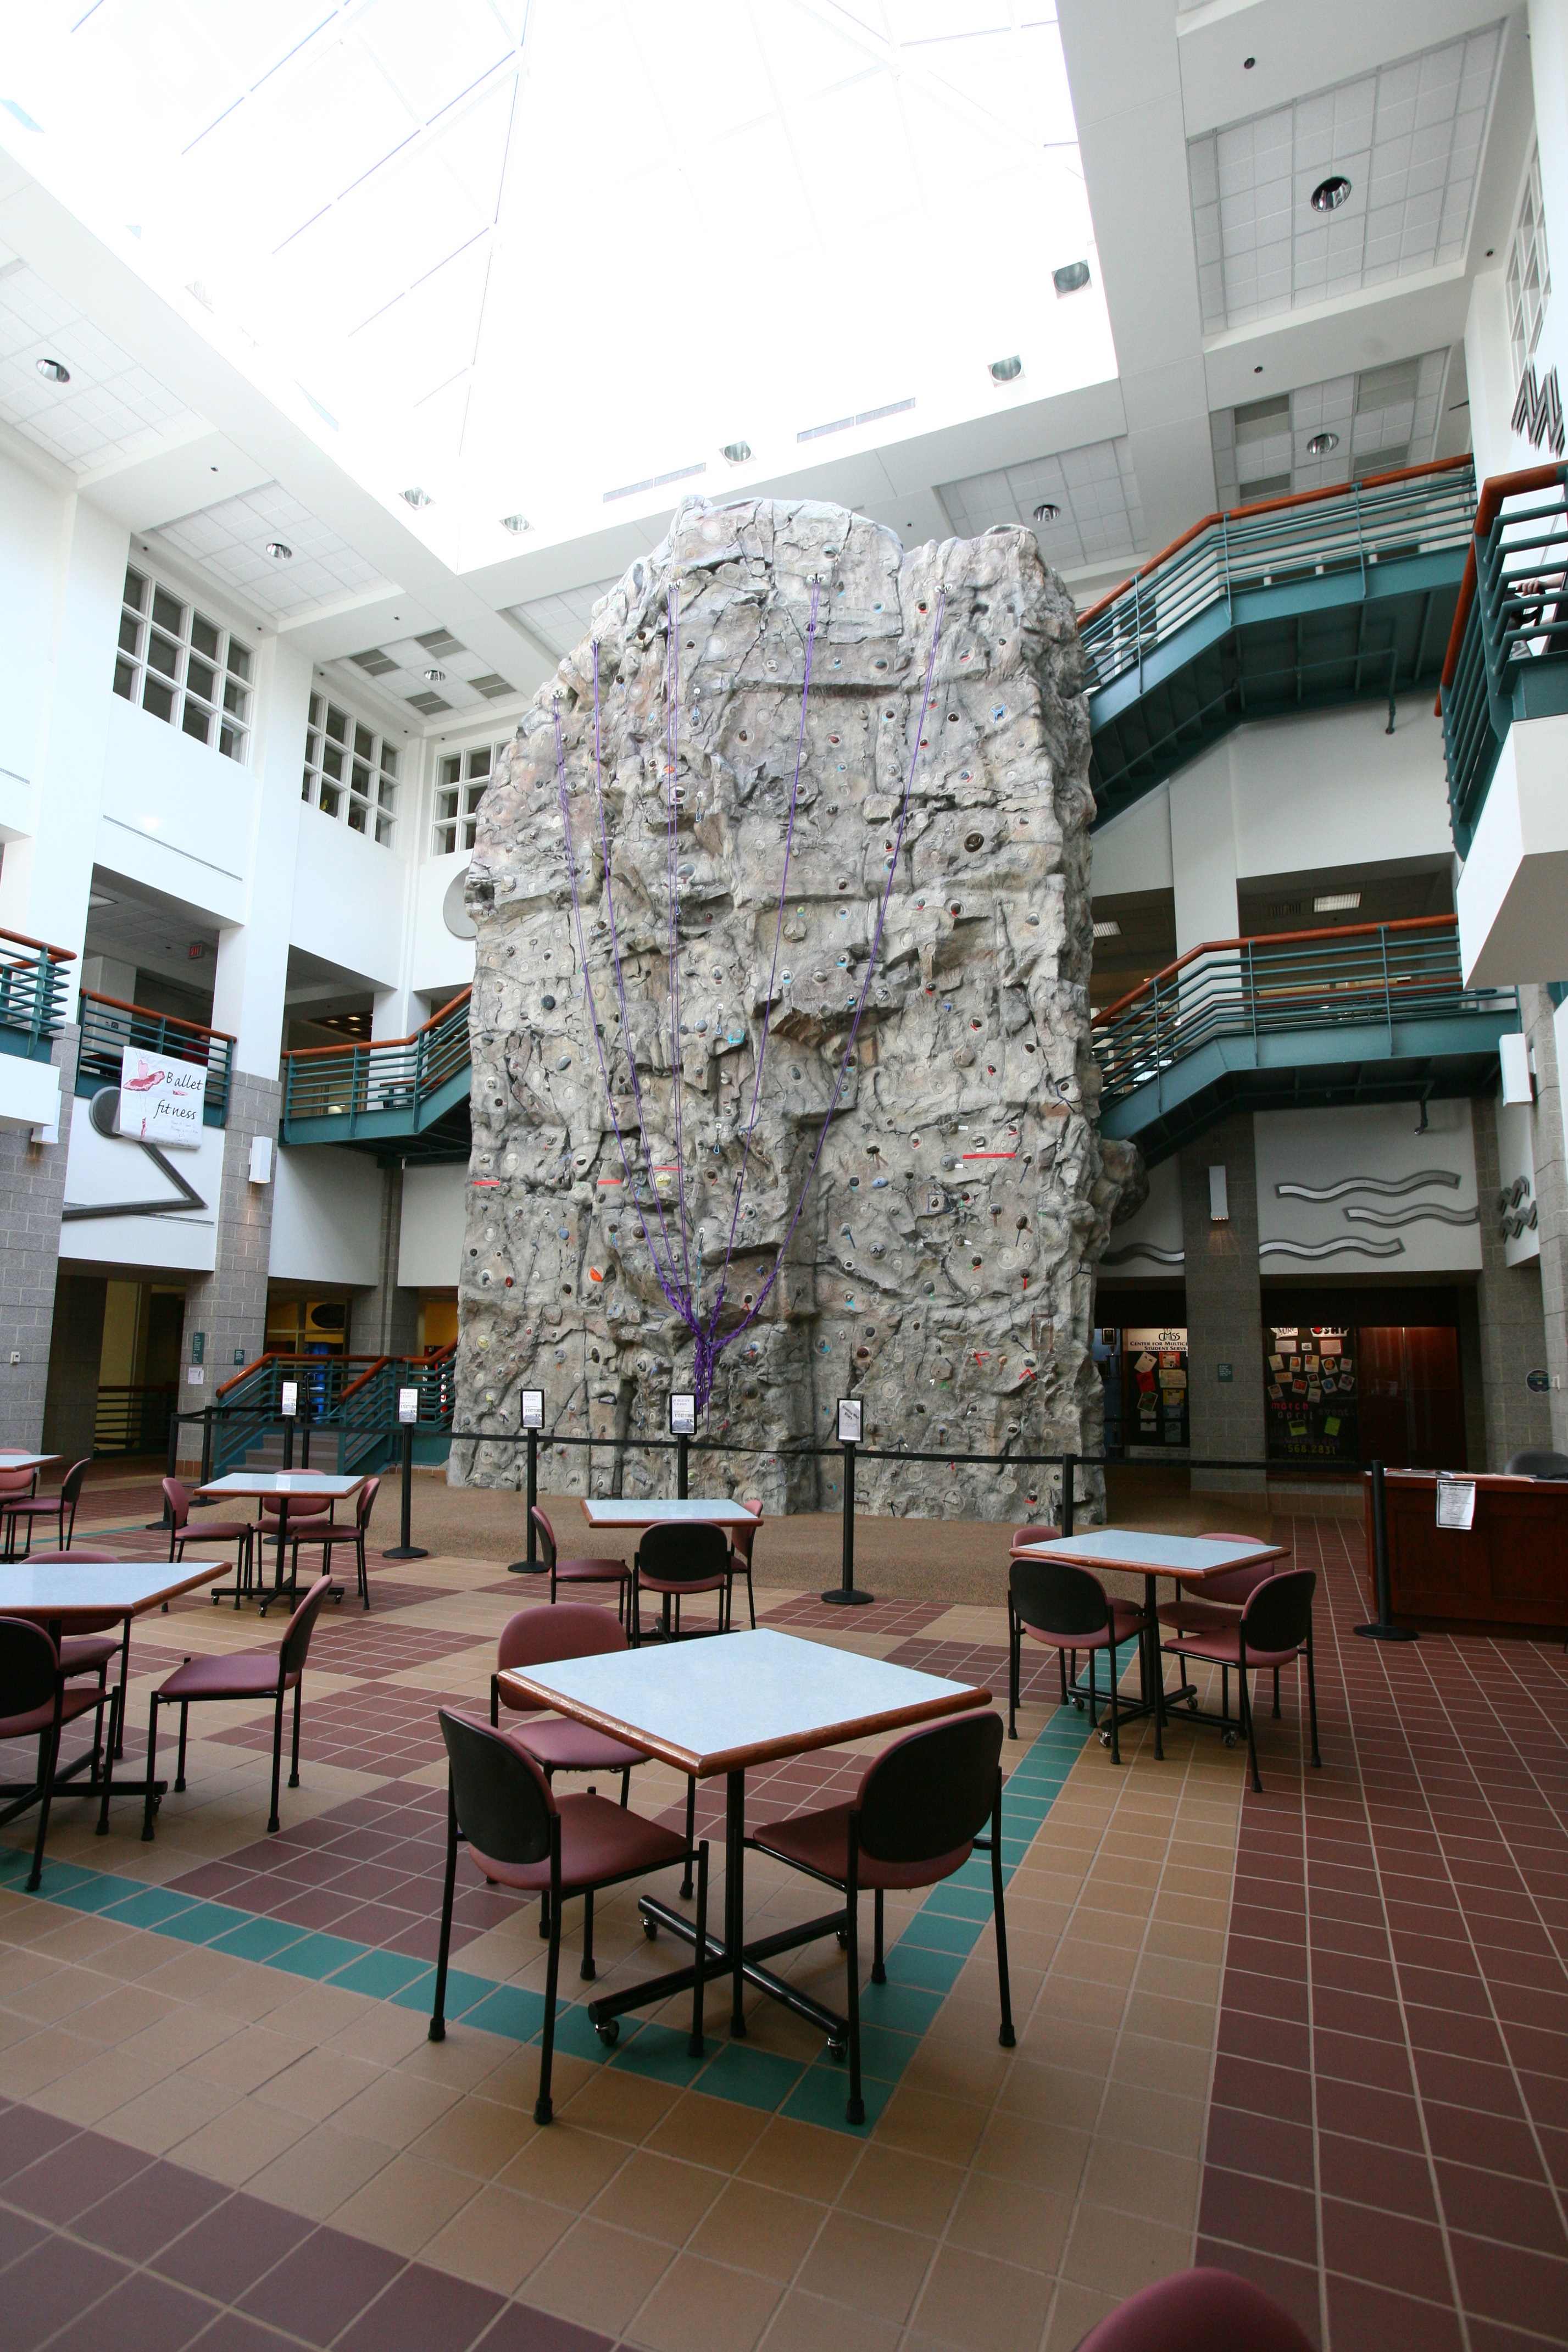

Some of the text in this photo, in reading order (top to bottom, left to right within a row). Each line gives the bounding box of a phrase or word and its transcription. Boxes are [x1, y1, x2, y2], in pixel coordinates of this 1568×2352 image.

[166, 1071, 204, 1091] Ballet
[153, 1099, 197, 1120] fitness
[1271, 1402, 1309, 1410] march
[1277, 1411, 1313, 1420] april
[1318, 1408, 1355, 1416] events
